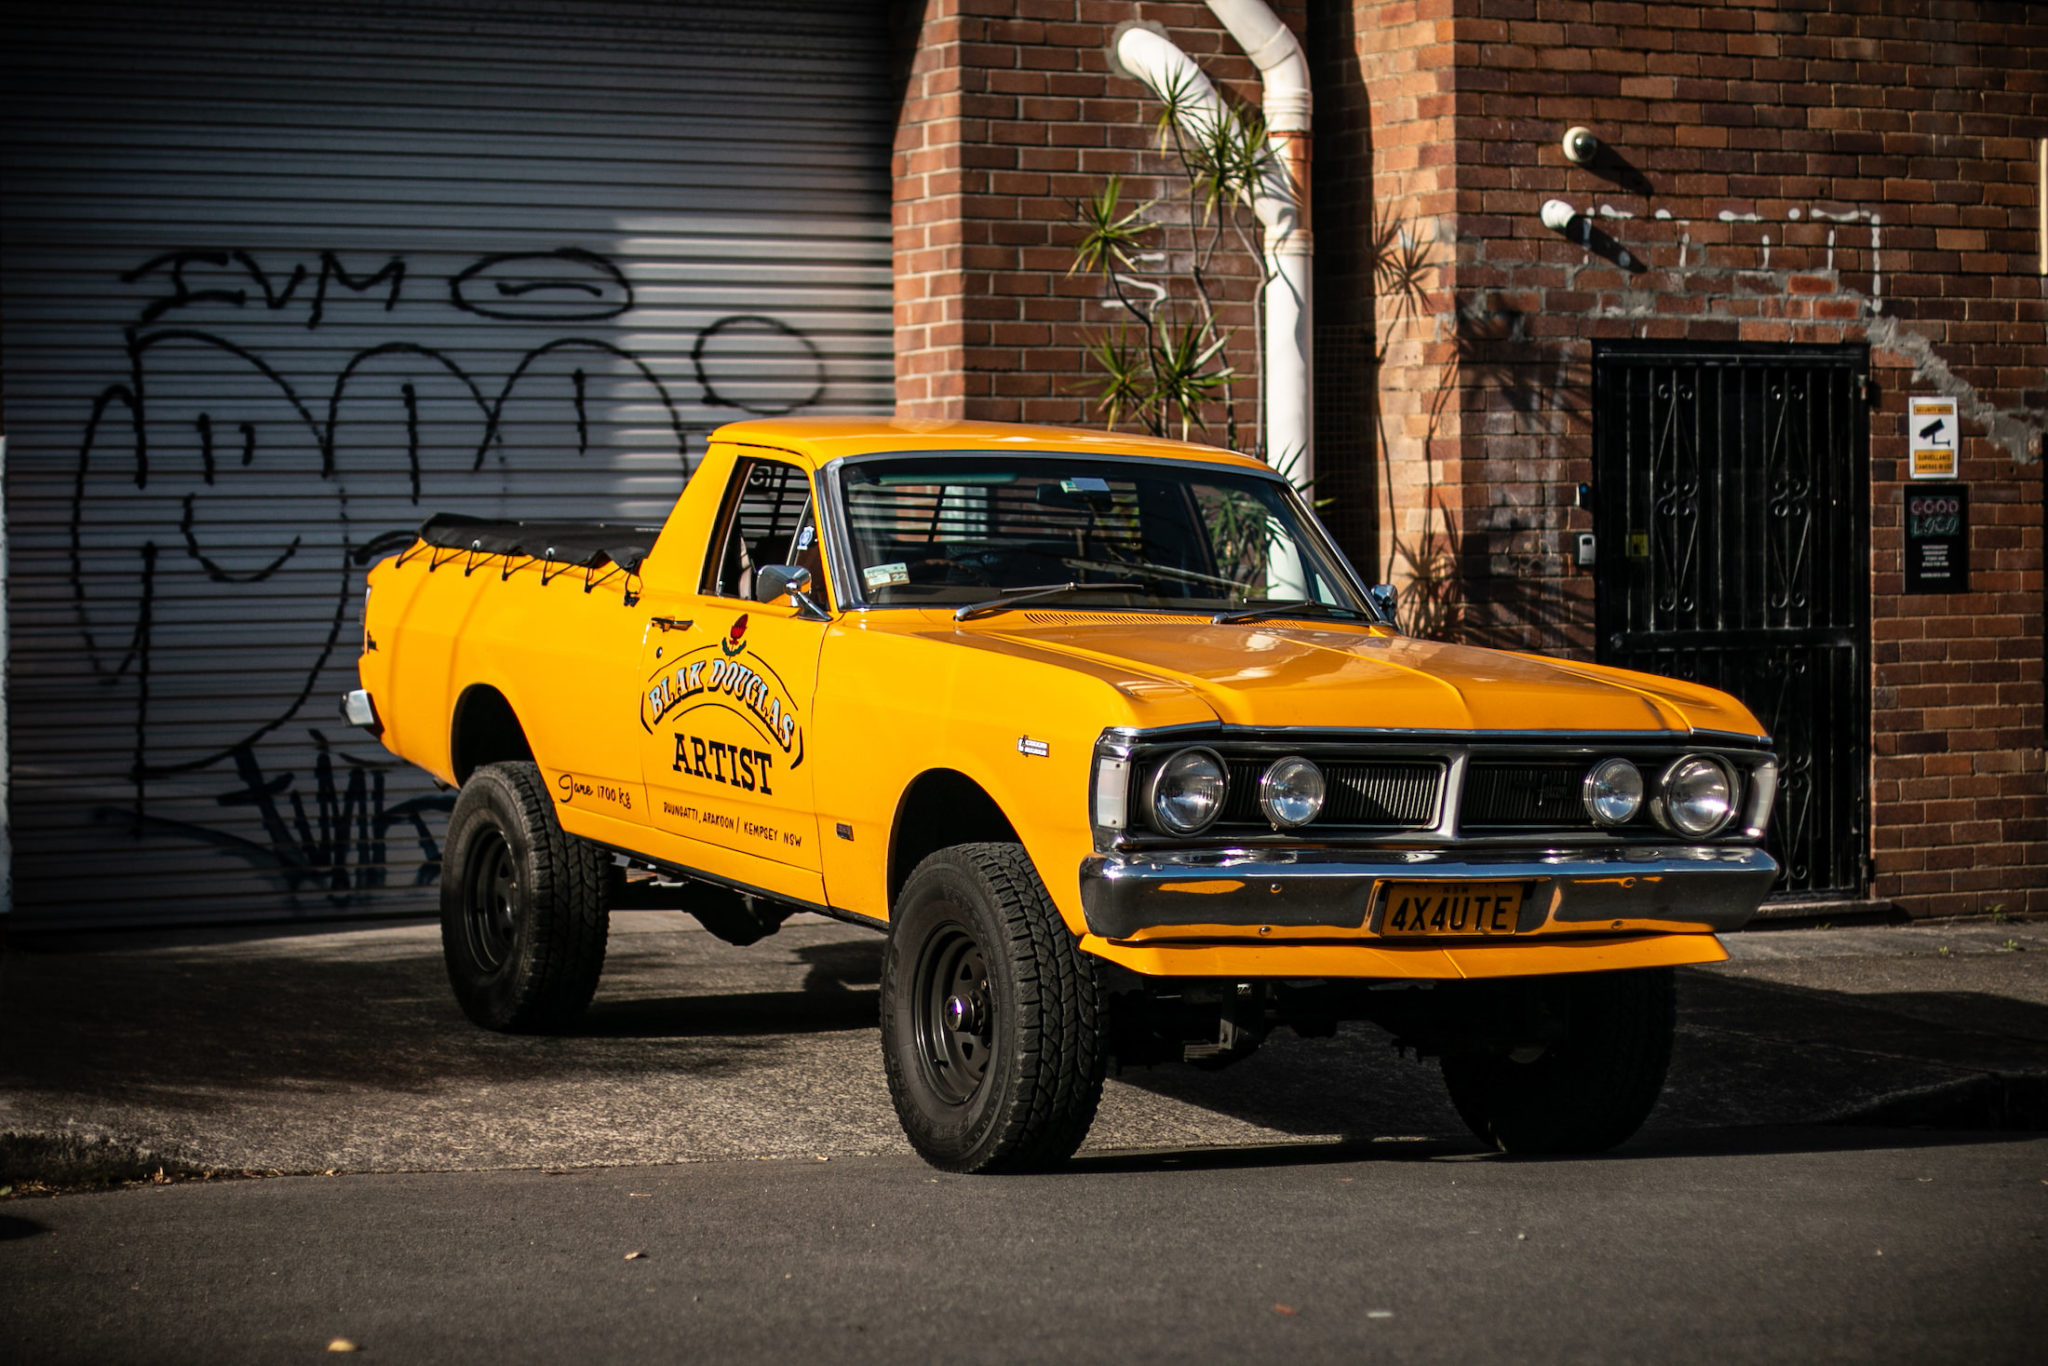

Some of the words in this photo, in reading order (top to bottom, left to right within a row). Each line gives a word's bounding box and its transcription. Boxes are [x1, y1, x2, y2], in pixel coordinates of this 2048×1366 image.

[648, 660, 707, 725] BLAK
[707, 658, 795, 752] DOUGLAS
[672, 732, 773, 795] ARTIST
[597, 784, 616, 802] 1700
[743, 821, 778, 841] KEMPSEY
[783, 831, 802, 848] NSW
[1391, 896, 1513, 931] 4X4UTE
